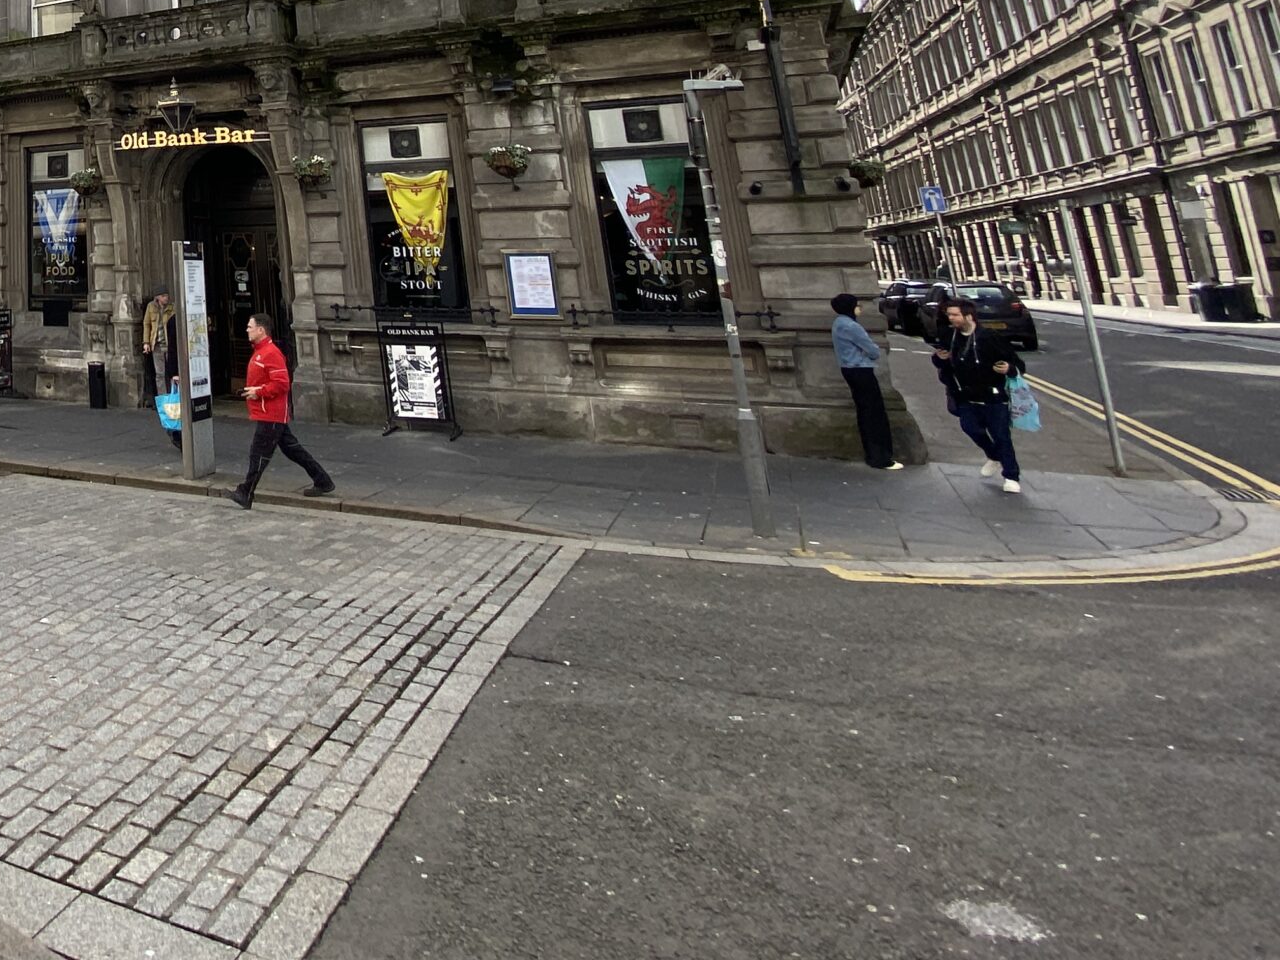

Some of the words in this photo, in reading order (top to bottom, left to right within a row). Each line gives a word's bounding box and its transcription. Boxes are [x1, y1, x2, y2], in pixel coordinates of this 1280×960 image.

[121, 132, 149, 150] Old
[154, 128, 208, 148] Bank
[214, 127, 257, 144] Bar
[646, 226, 673, 234] FINE
[629, 237, 698, 247] SCOTTISH
[51, 253, 70, 262] PUB
[392, 246, 441, 258] BITTER
[46, 266, 75, 276] FOOD
[405, 261, 436, 276] IPA
[625, 259, 708, 275] SPIRITS
[400, 280, 442, 290] STOUT
[636, 287, 678, 301] WHISKY
[688, 287, 708, 299] GIN
